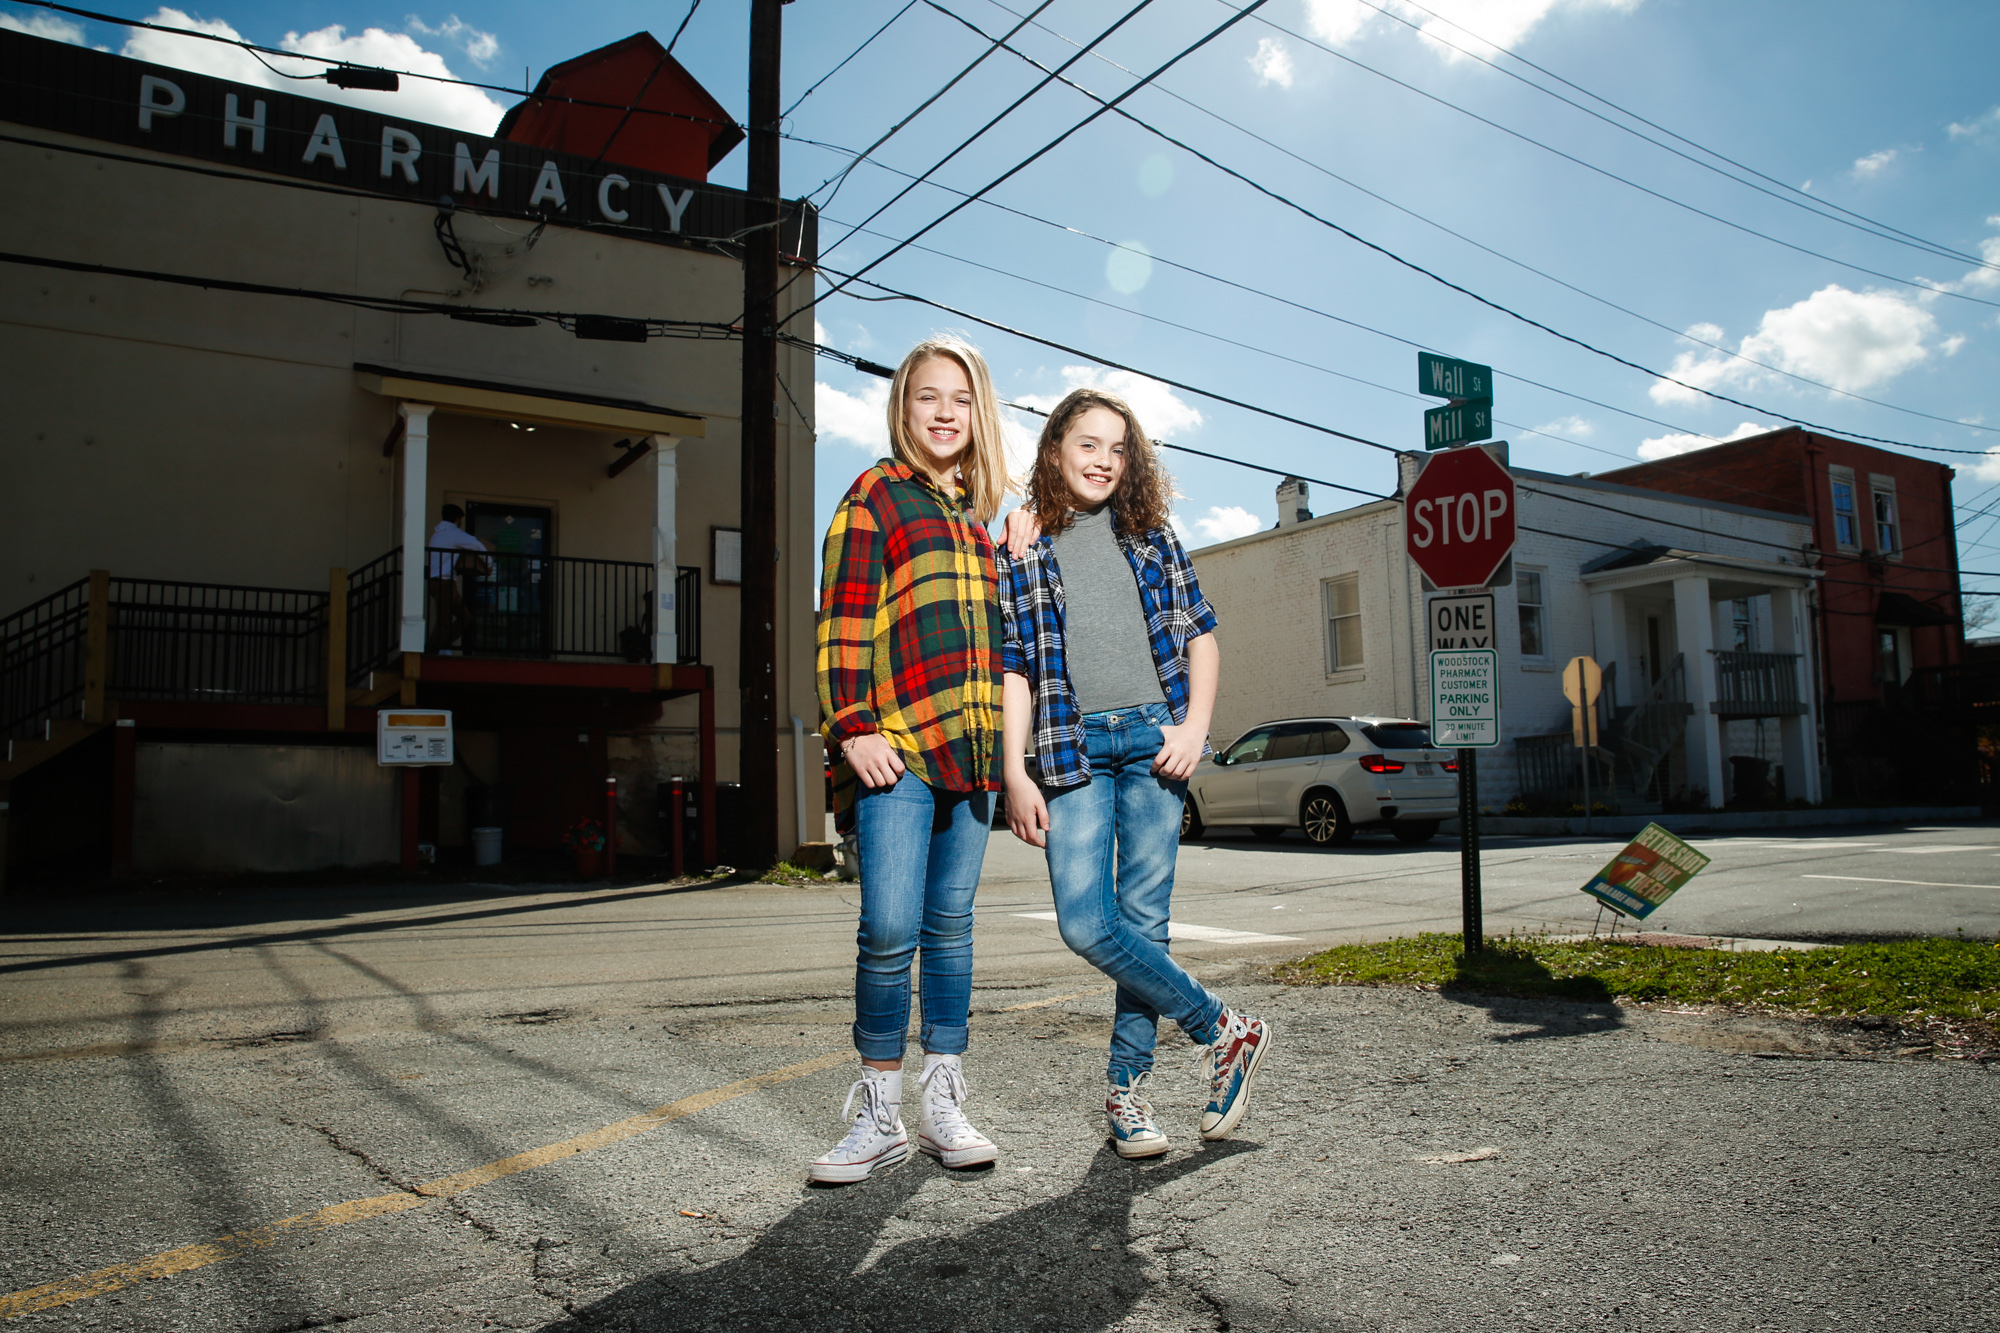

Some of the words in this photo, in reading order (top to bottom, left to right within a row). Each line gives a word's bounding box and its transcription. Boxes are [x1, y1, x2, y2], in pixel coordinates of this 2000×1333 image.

[138, 74, 694, 233] PHARMACY
[1431, 361, 1463, 395] Wall
[1473, 376, 1482, 392] St
[1430, 409, 1462, 443] Mill
[1475, 412, 1485, 427] St
[1413, 489, 1507, 548] STOP
[1438, 604, 1486, 632] ONE
[1437, 656, 1490, 667] WOODSTOCK
[1440, 668, 1488, 678] PHARMACY
[1441, 680, 1487, 690] CUSTOMER
[1440, 693, 1489, 704] PARKING
[1449, 705, 1480, 716] ONLY
[1446, 723, 1455, 731] 30
[1458, 722, 1485, 731] MINUTE
[1456, 732, 1475, 741] LIMIT
[1636, 826, 1662, 849] GET
[1652, 833, 1682, 859] THE
[1672, 846, 1707, 875] SHOT
[1649, 861, 1682, 885] NOT
[1625, 871, 1656, 894] THE
[1642, 881, 1674, 905] FLU
